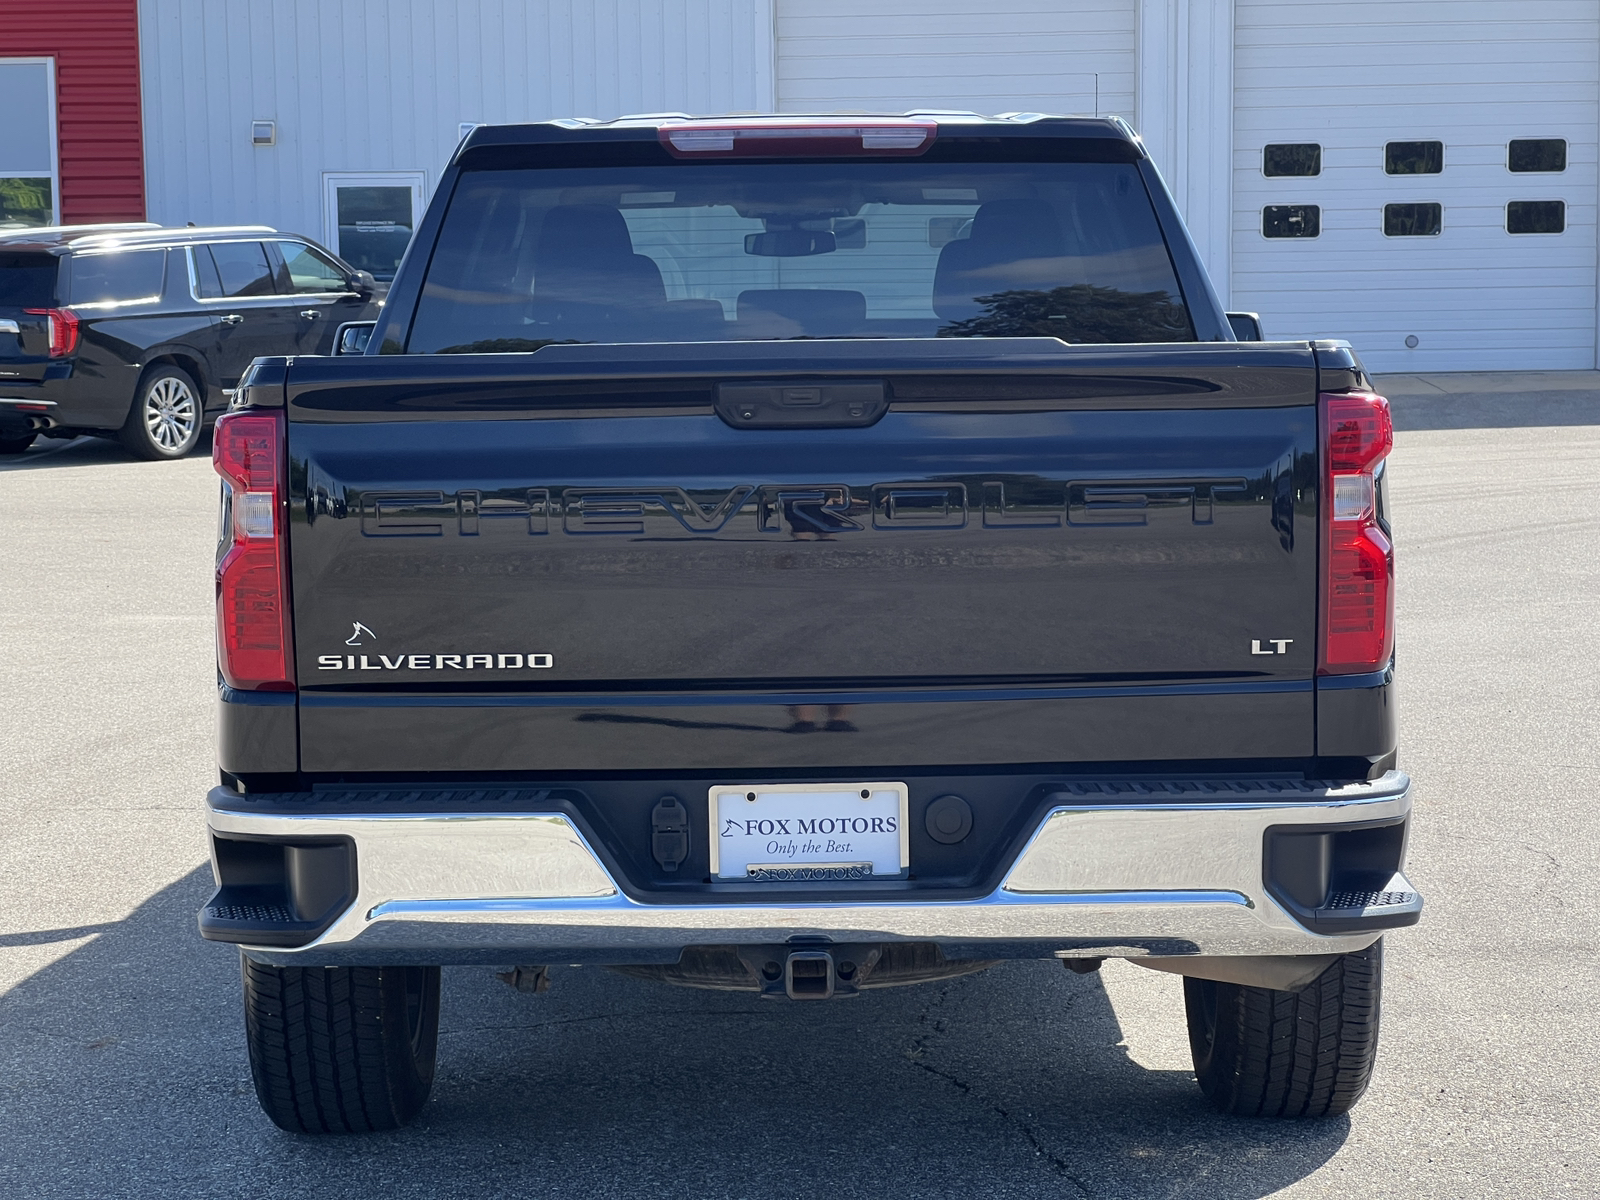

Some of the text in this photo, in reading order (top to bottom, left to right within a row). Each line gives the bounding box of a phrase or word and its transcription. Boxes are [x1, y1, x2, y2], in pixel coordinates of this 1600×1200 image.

[359, 477, 1248, 538] CHEVROLET
[1251, 639, 1294, 655] LT
[318, 653, 554, 670] SILVERADO
[744, 817, 897, 836] FOX MOTORS
[766, 840, 854, 858] Only the Best.
[768, 867, 863, 880] FOX MOTORS
